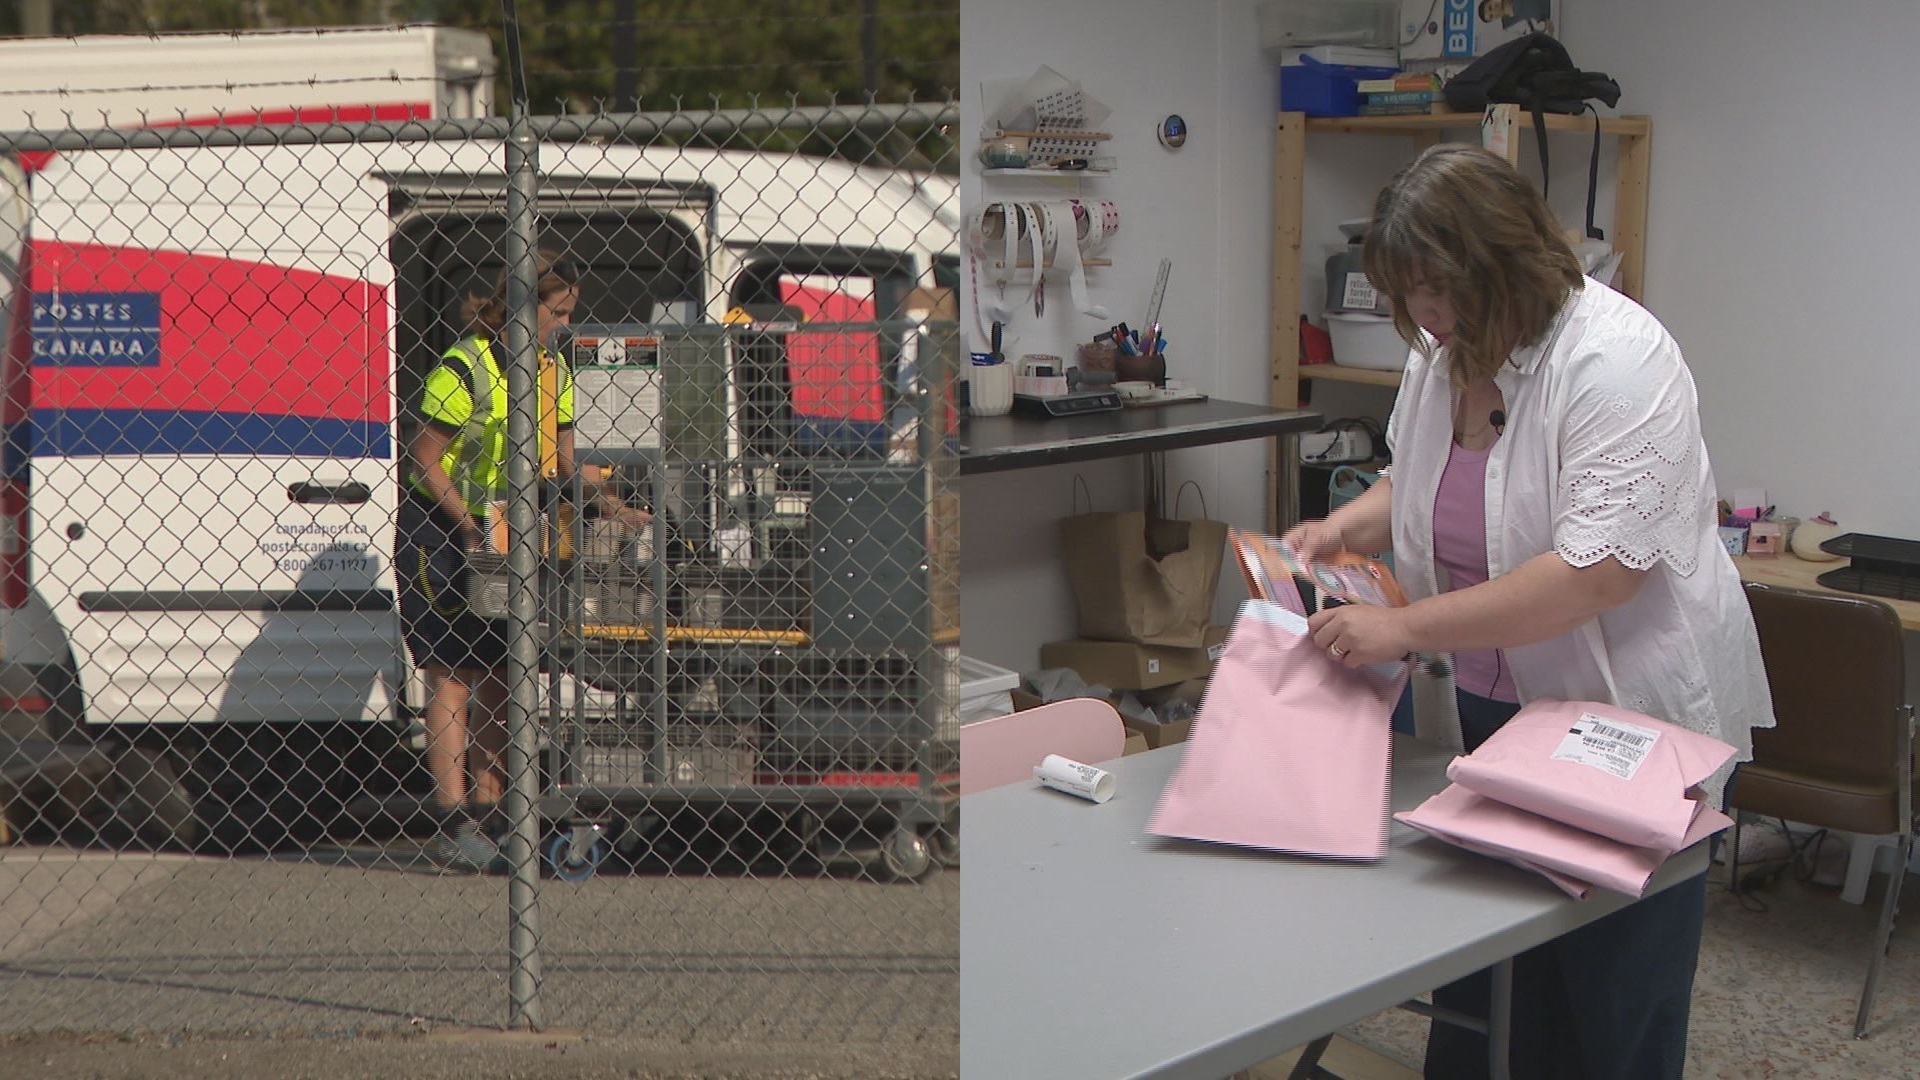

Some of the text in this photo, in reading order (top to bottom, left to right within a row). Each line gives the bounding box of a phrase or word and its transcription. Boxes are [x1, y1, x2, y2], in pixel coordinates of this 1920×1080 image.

[33, 303, 132, 321] POSTES
[32, 339, 144, 356] CANADA
[275, 524, 368, 537] canadapost.ca
[262, 541, 368, 555] postescanadaca
[273, 559, 367, 571] -800-267-1177
